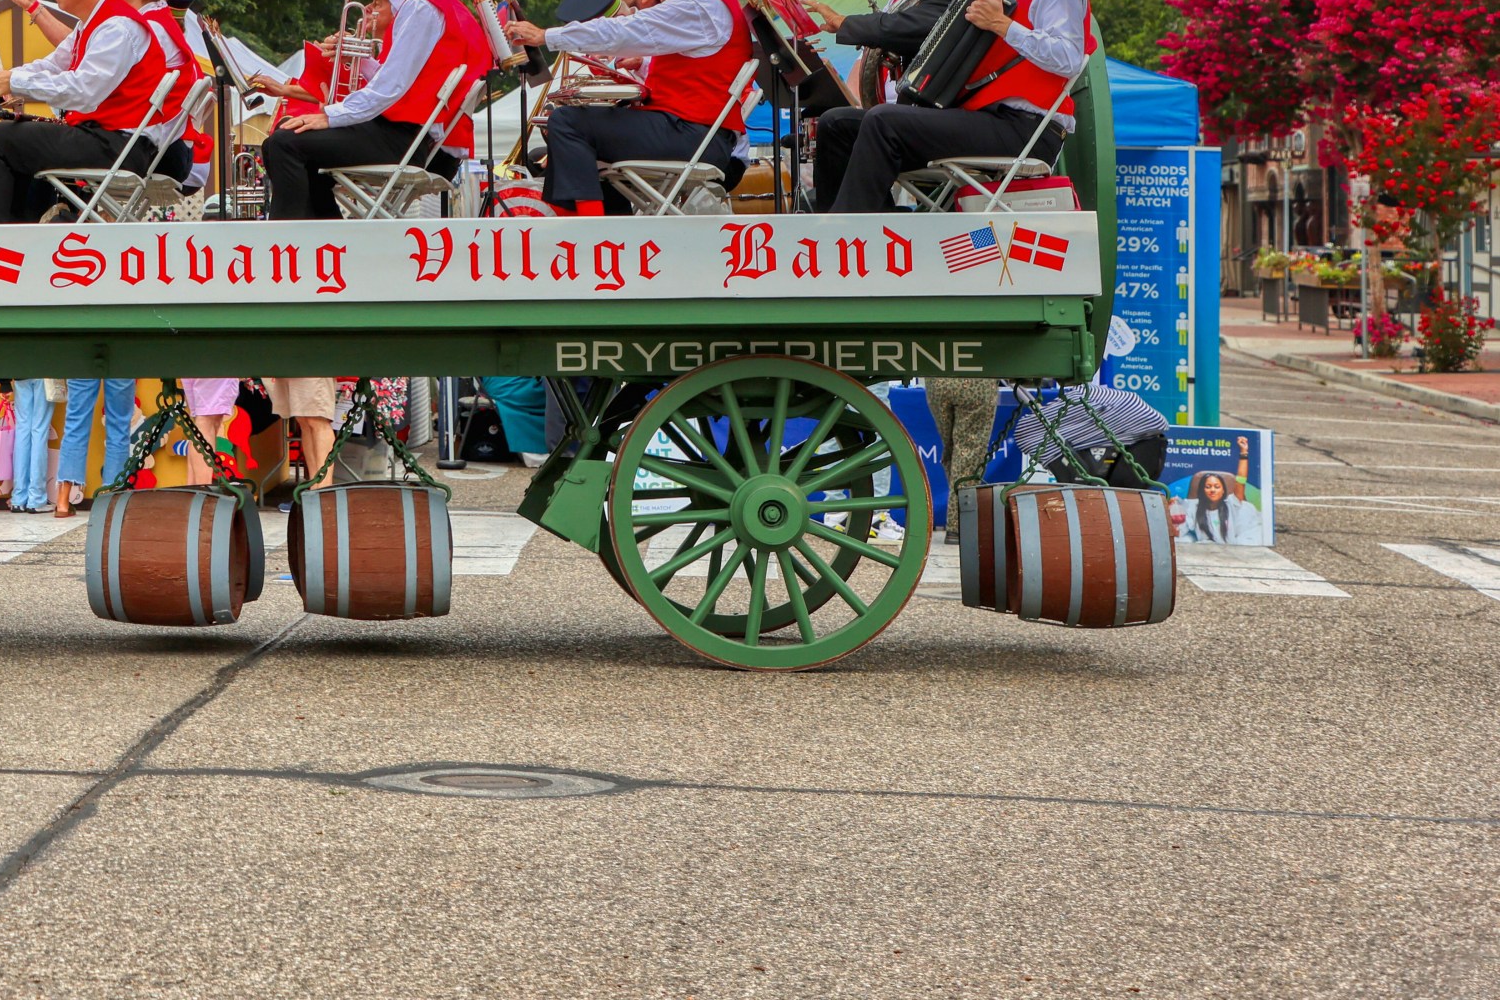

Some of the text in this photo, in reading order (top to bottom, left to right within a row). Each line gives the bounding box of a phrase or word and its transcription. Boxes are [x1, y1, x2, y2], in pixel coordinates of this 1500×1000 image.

[1150, 166, 1187, 175] ODDS
[1124, 176, 1177, 186] FINDING
[1116, 186, 1189, 197] IFE-SAVING
[1125, 197, 1171, 207] MATCH
[1117, 236, 1160, 253] 29%
[50, 222, 915, 294] Solvang Village Band
[1140, 264, 1163, 272] Pacific
[1115, 282, 1160, 299] 47%
[1122, 310, 1151, 318] Hispanic
[1131, 328, 1160, 345] 8%
[1125, 355, 1148, 363] Native
[1121, 363, 1153, 371] American
[1113, 373, 1161, 391] 60%
[1176, 438, 1205, 447] saved
[1214, 439, 1231, 448] life
[1181, 447, 1209, 455] could
